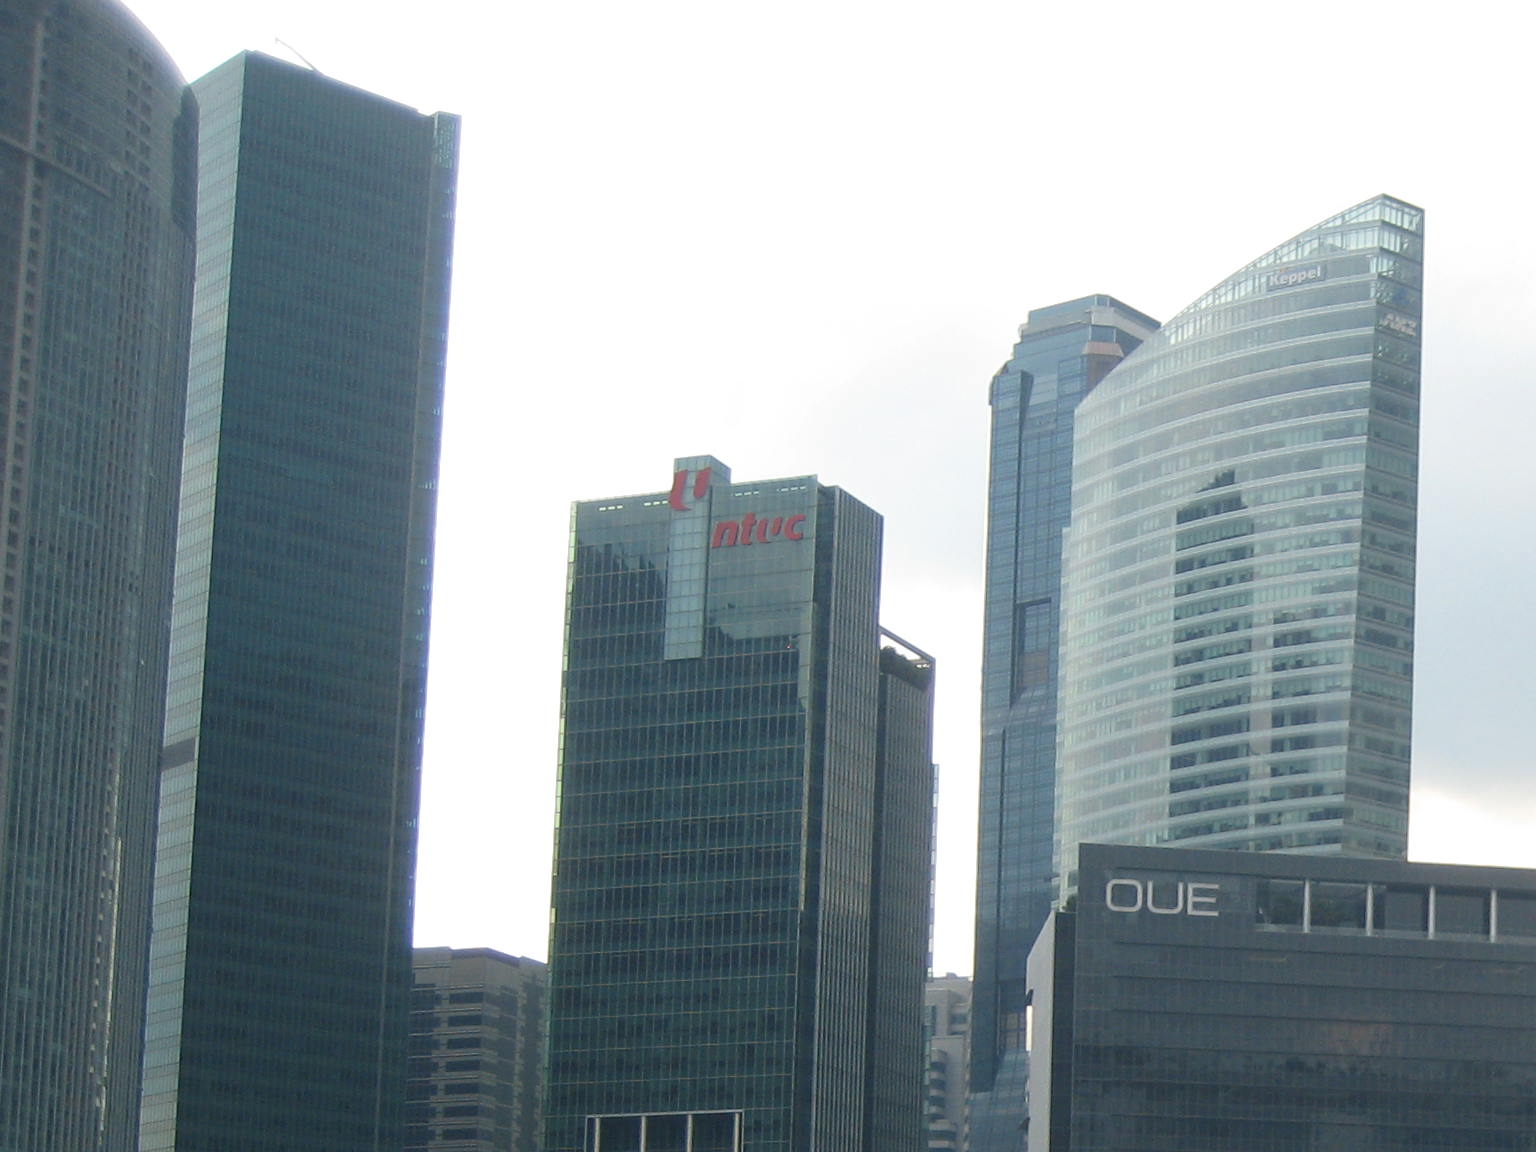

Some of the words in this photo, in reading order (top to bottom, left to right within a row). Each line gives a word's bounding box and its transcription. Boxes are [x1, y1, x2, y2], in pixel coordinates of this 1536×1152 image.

[1269, 265, 1321, 286] Keppel
[711, 512, 807, 548] ntuc
[1105, 878, 1220, 917] OUE
